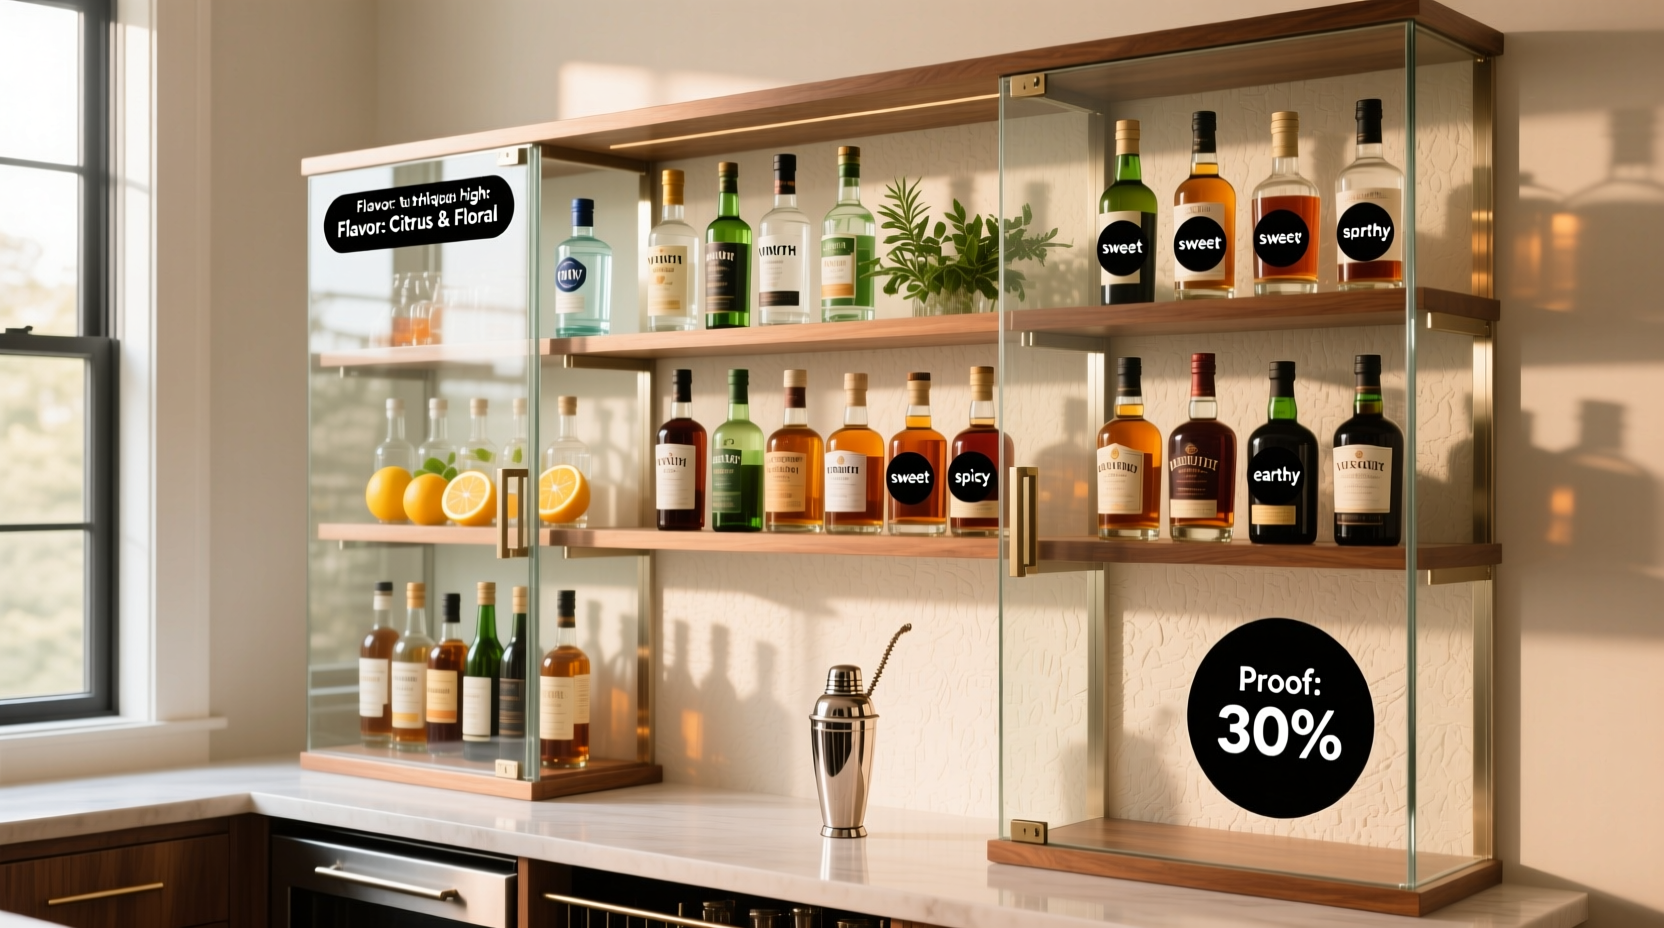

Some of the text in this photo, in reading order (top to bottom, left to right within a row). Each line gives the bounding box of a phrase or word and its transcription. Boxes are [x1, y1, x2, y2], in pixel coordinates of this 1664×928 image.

[337, 204, 498, 238] Flavor: Citrus & Floral
[1102, 239, 1143, 254] sweet
[1178, 236, 1222, 251] sweet
[891, 470, 930, 484] sweet
[955, 468, 990, 487] spicy
[1253, 466, 1301, 486] earthy
[1239, 665, 1321, 696] Proof:
[1217, 704, 1342, 761] 30%
